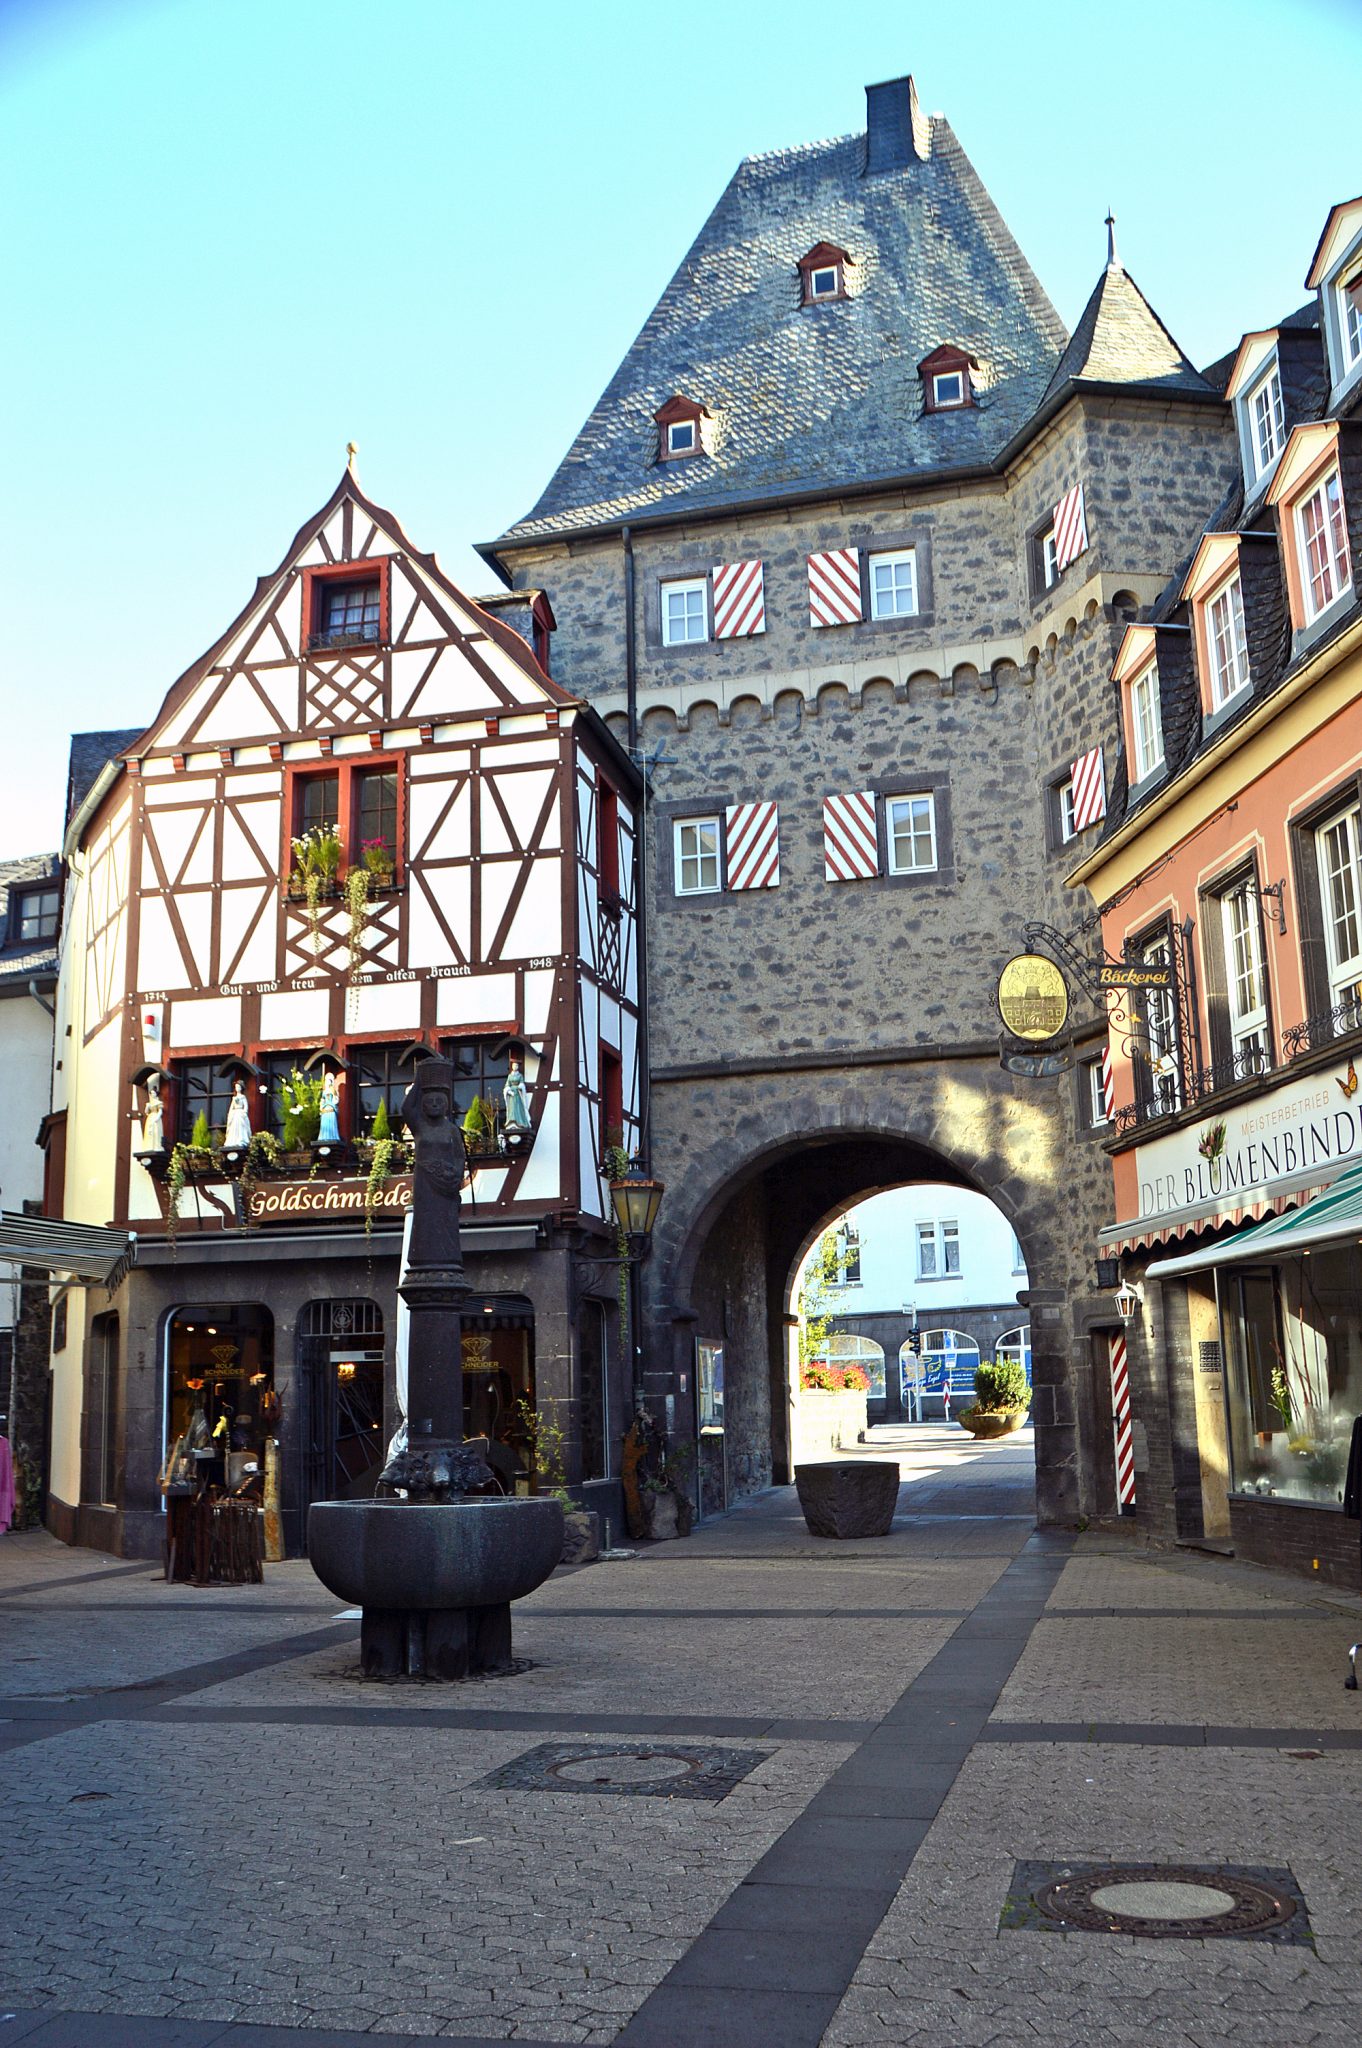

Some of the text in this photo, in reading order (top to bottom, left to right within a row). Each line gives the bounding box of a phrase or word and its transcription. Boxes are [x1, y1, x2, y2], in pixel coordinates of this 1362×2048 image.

[220, 984, 243, 996] Gut
[256, 980, 278, 993] und
[291, 978, 315, 990] treu
[386, 970, 417, 982] alten
[430, 965, 471, 978] Brauch
[528, 957, 552, 969] 1948
[1100, 967, 1170, 986] Bäckerei
[1240, 1090, 1330, 1136] MEISTERBETRIEB
[250, 1182, 413, 1217] Goldschmiede
[1141, 1174, 1180, 1218] DER
